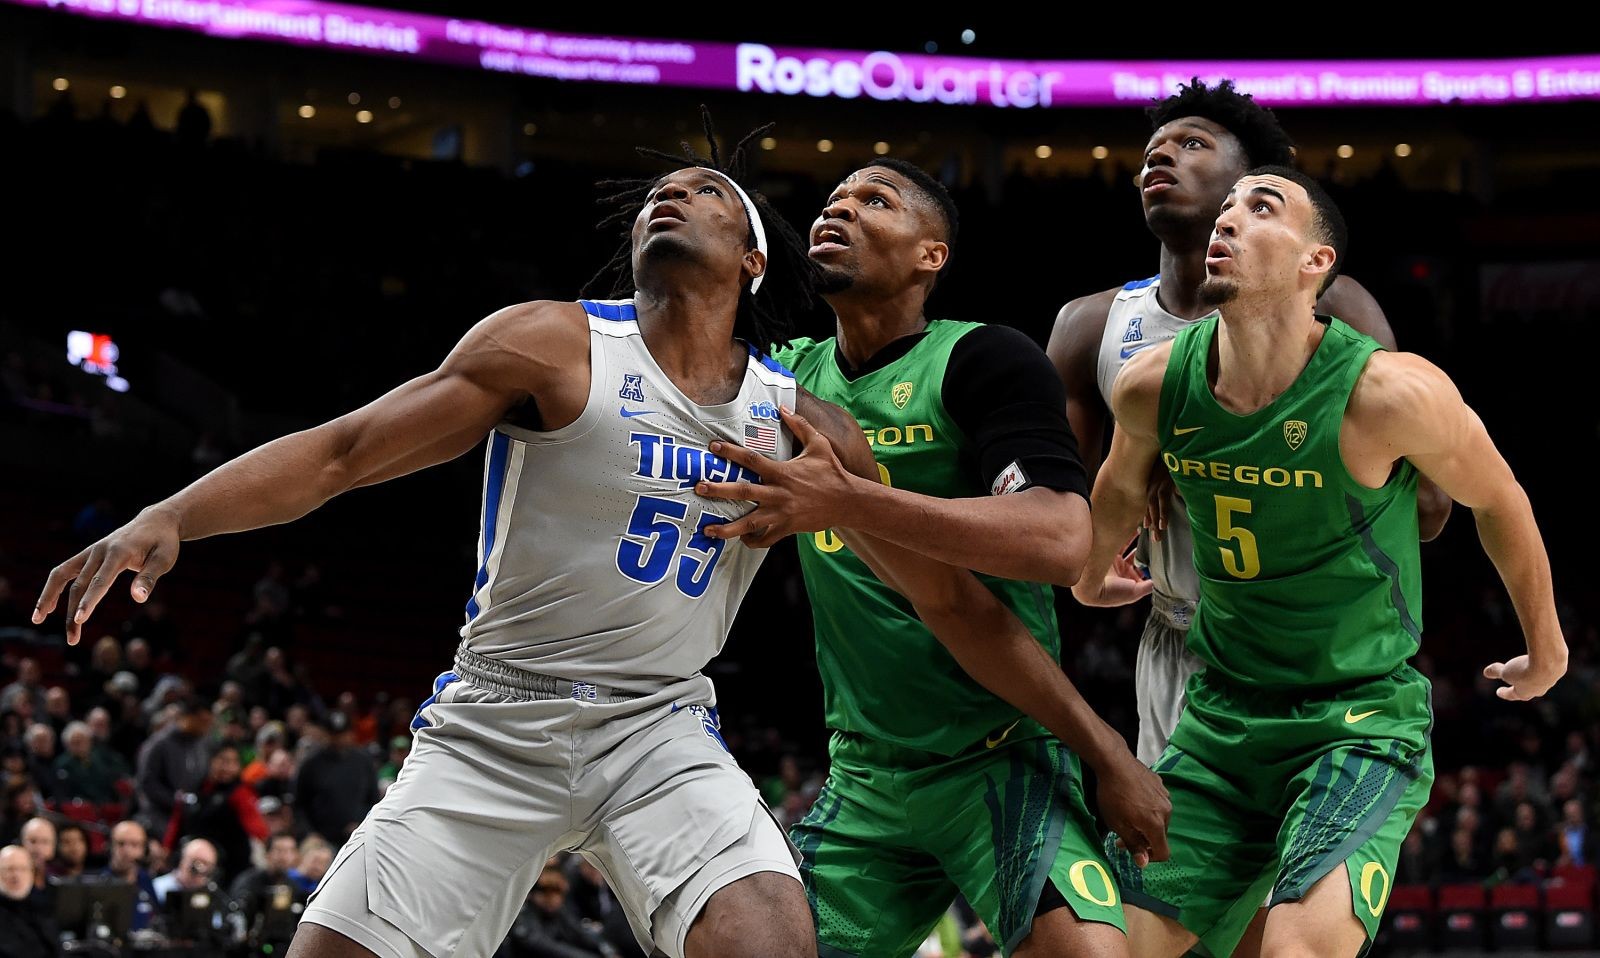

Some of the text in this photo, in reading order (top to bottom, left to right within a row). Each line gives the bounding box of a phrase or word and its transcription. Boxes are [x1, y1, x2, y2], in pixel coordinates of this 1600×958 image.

[324, 13, 418, 53] District
[736, 42, 1065, 108] RoseQuarter
[615, 495, 733, 599] 55
[1214, 494, 1260, 579] 5
